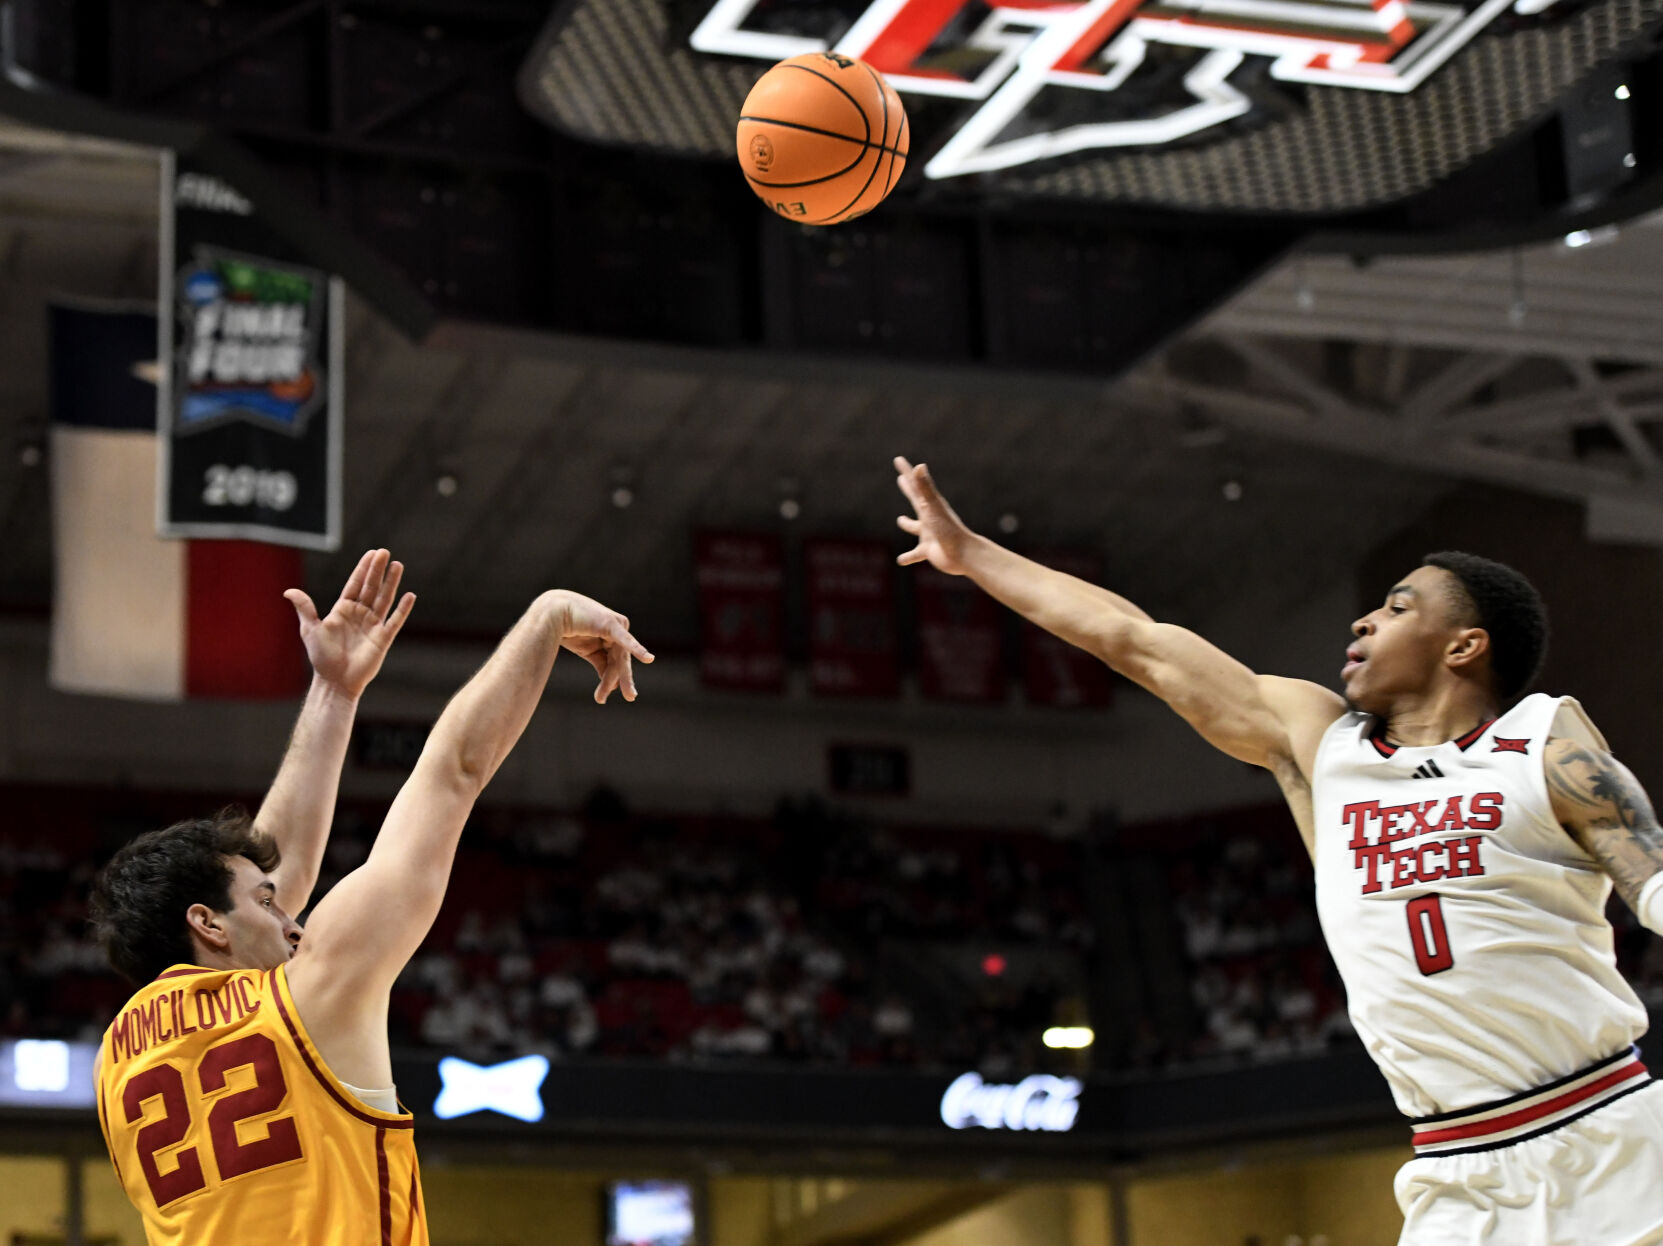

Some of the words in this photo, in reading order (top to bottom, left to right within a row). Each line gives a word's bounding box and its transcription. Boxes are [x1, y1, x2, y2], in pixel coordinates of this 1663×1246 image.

[194, 303, 305, 339] FINAL
[188, 340, 304, 382] FOUR
[202, 464, 297, 512] 2019
[1342, 792, 1504, 850] TEXAS
[1354, 836, 1486, 895] TECH
[1405, 892, 1454, 976] 0
[111, 976, 261, 1064] MOMCILOVIC
[121, 1032, 304, 1209] 22
